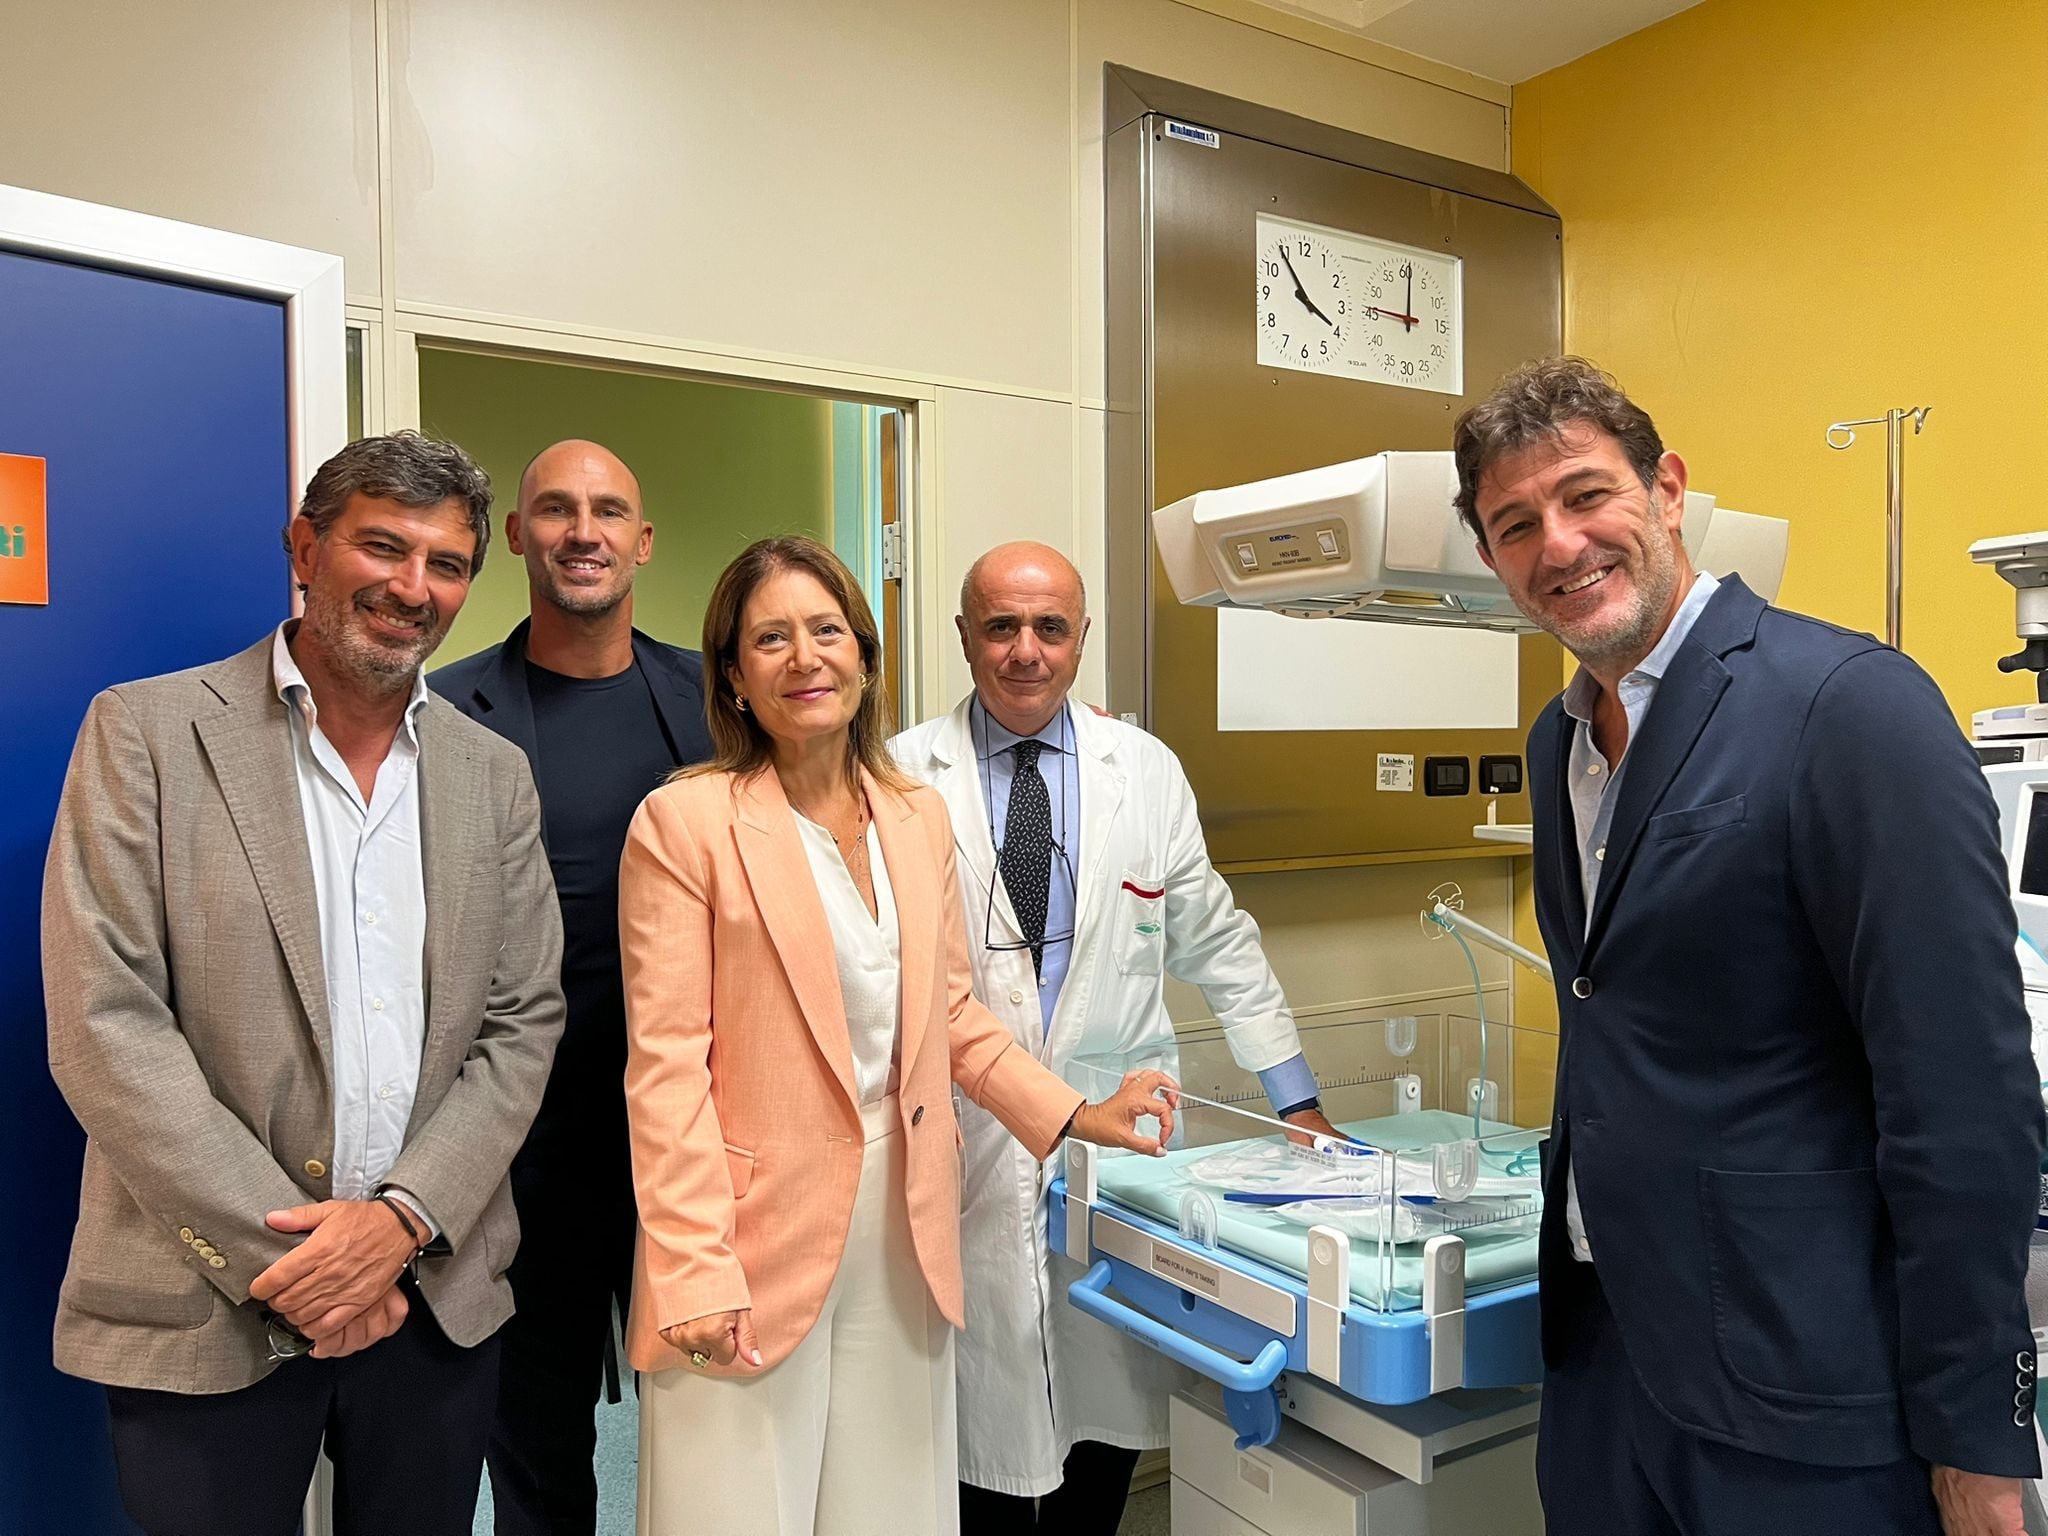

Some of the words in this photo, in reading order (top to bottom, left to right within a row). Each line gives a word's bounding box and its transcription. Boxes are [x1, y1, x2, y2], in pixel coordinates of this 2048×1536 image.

[1298, 241, 1311, 258] 12
[1321, 253, 1326, 268] 1
[1265, 261, 1279, 278] 10
[1383, 270, 1394, 282] 55
[1399, 264, 1412, 279] 60
[1332, 274, 1340, 289] 2
[1421, 279, 1427, 290] 5
[1262, 286, 1271, 300] 9
[1370, 286, 1382, 298] 50
[1338, 300, 1346, 315] 3
[1431, 297, 1441, 310] 10
[1267, 312, 1276, 328] 8
[1365, 306, 1379, 321] 45
[1333, 325, 1341, 338] 4
[1435, 320, 1447, 334] 15
[1281, 334, 1290, 348] 7
[1320, 341, 1328, 355] 5
[1372, 335, 1383, 347] 40
[1301, 344, 1309, 359] 6
[1430, 344, 1442, 357] 20
[1384, 354, 1396, 367] 35
[1418, 360, 1430, 372] 25
[1400, 361, 1414, 376] 30
